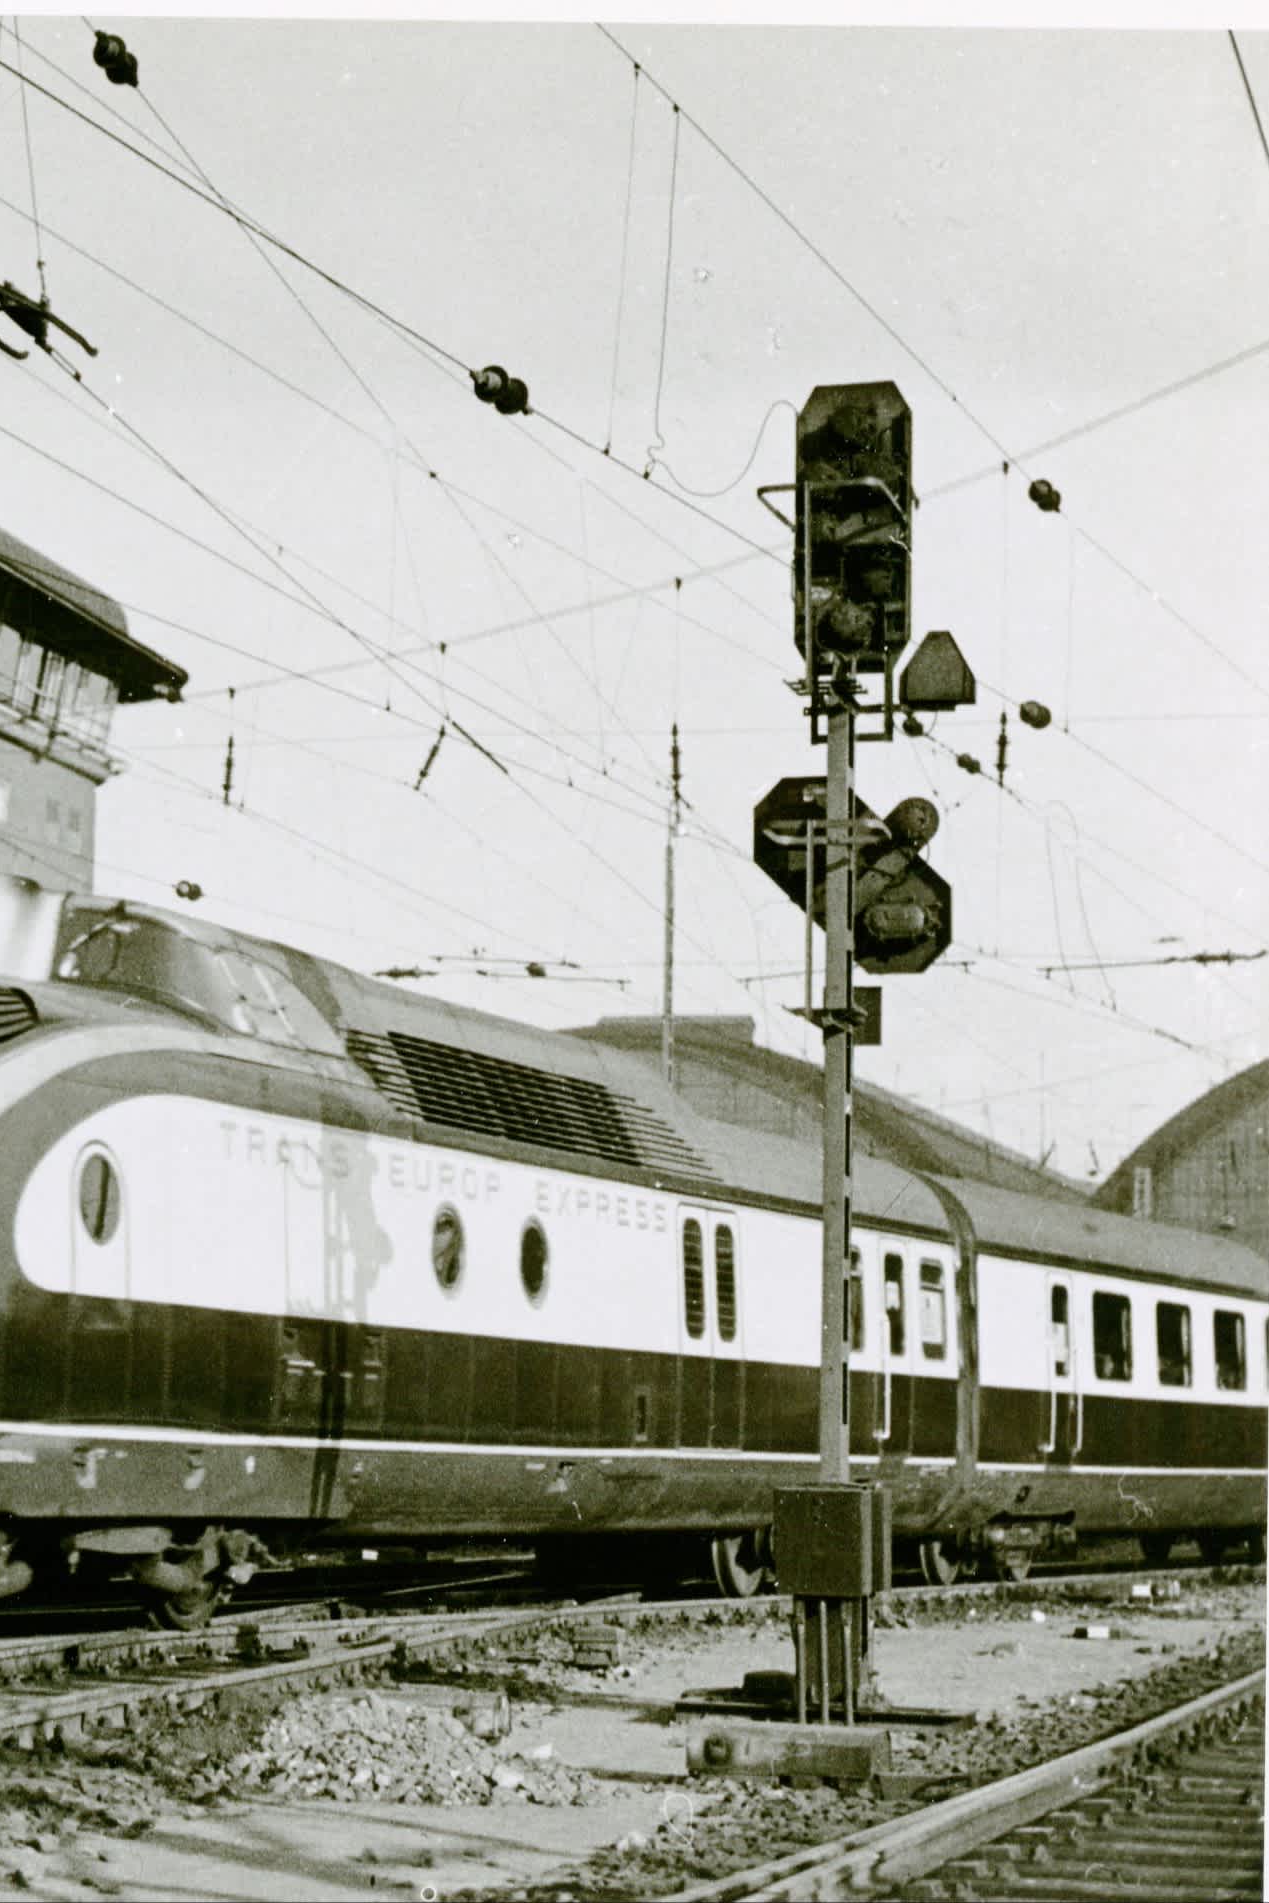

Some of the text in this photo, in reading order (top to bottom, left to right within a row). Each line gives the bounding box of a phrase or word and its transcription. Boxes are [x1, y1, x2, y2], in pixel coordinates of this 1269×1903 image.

[219, 1121, 669, 1233] TRANS EUROP EXPRESS
